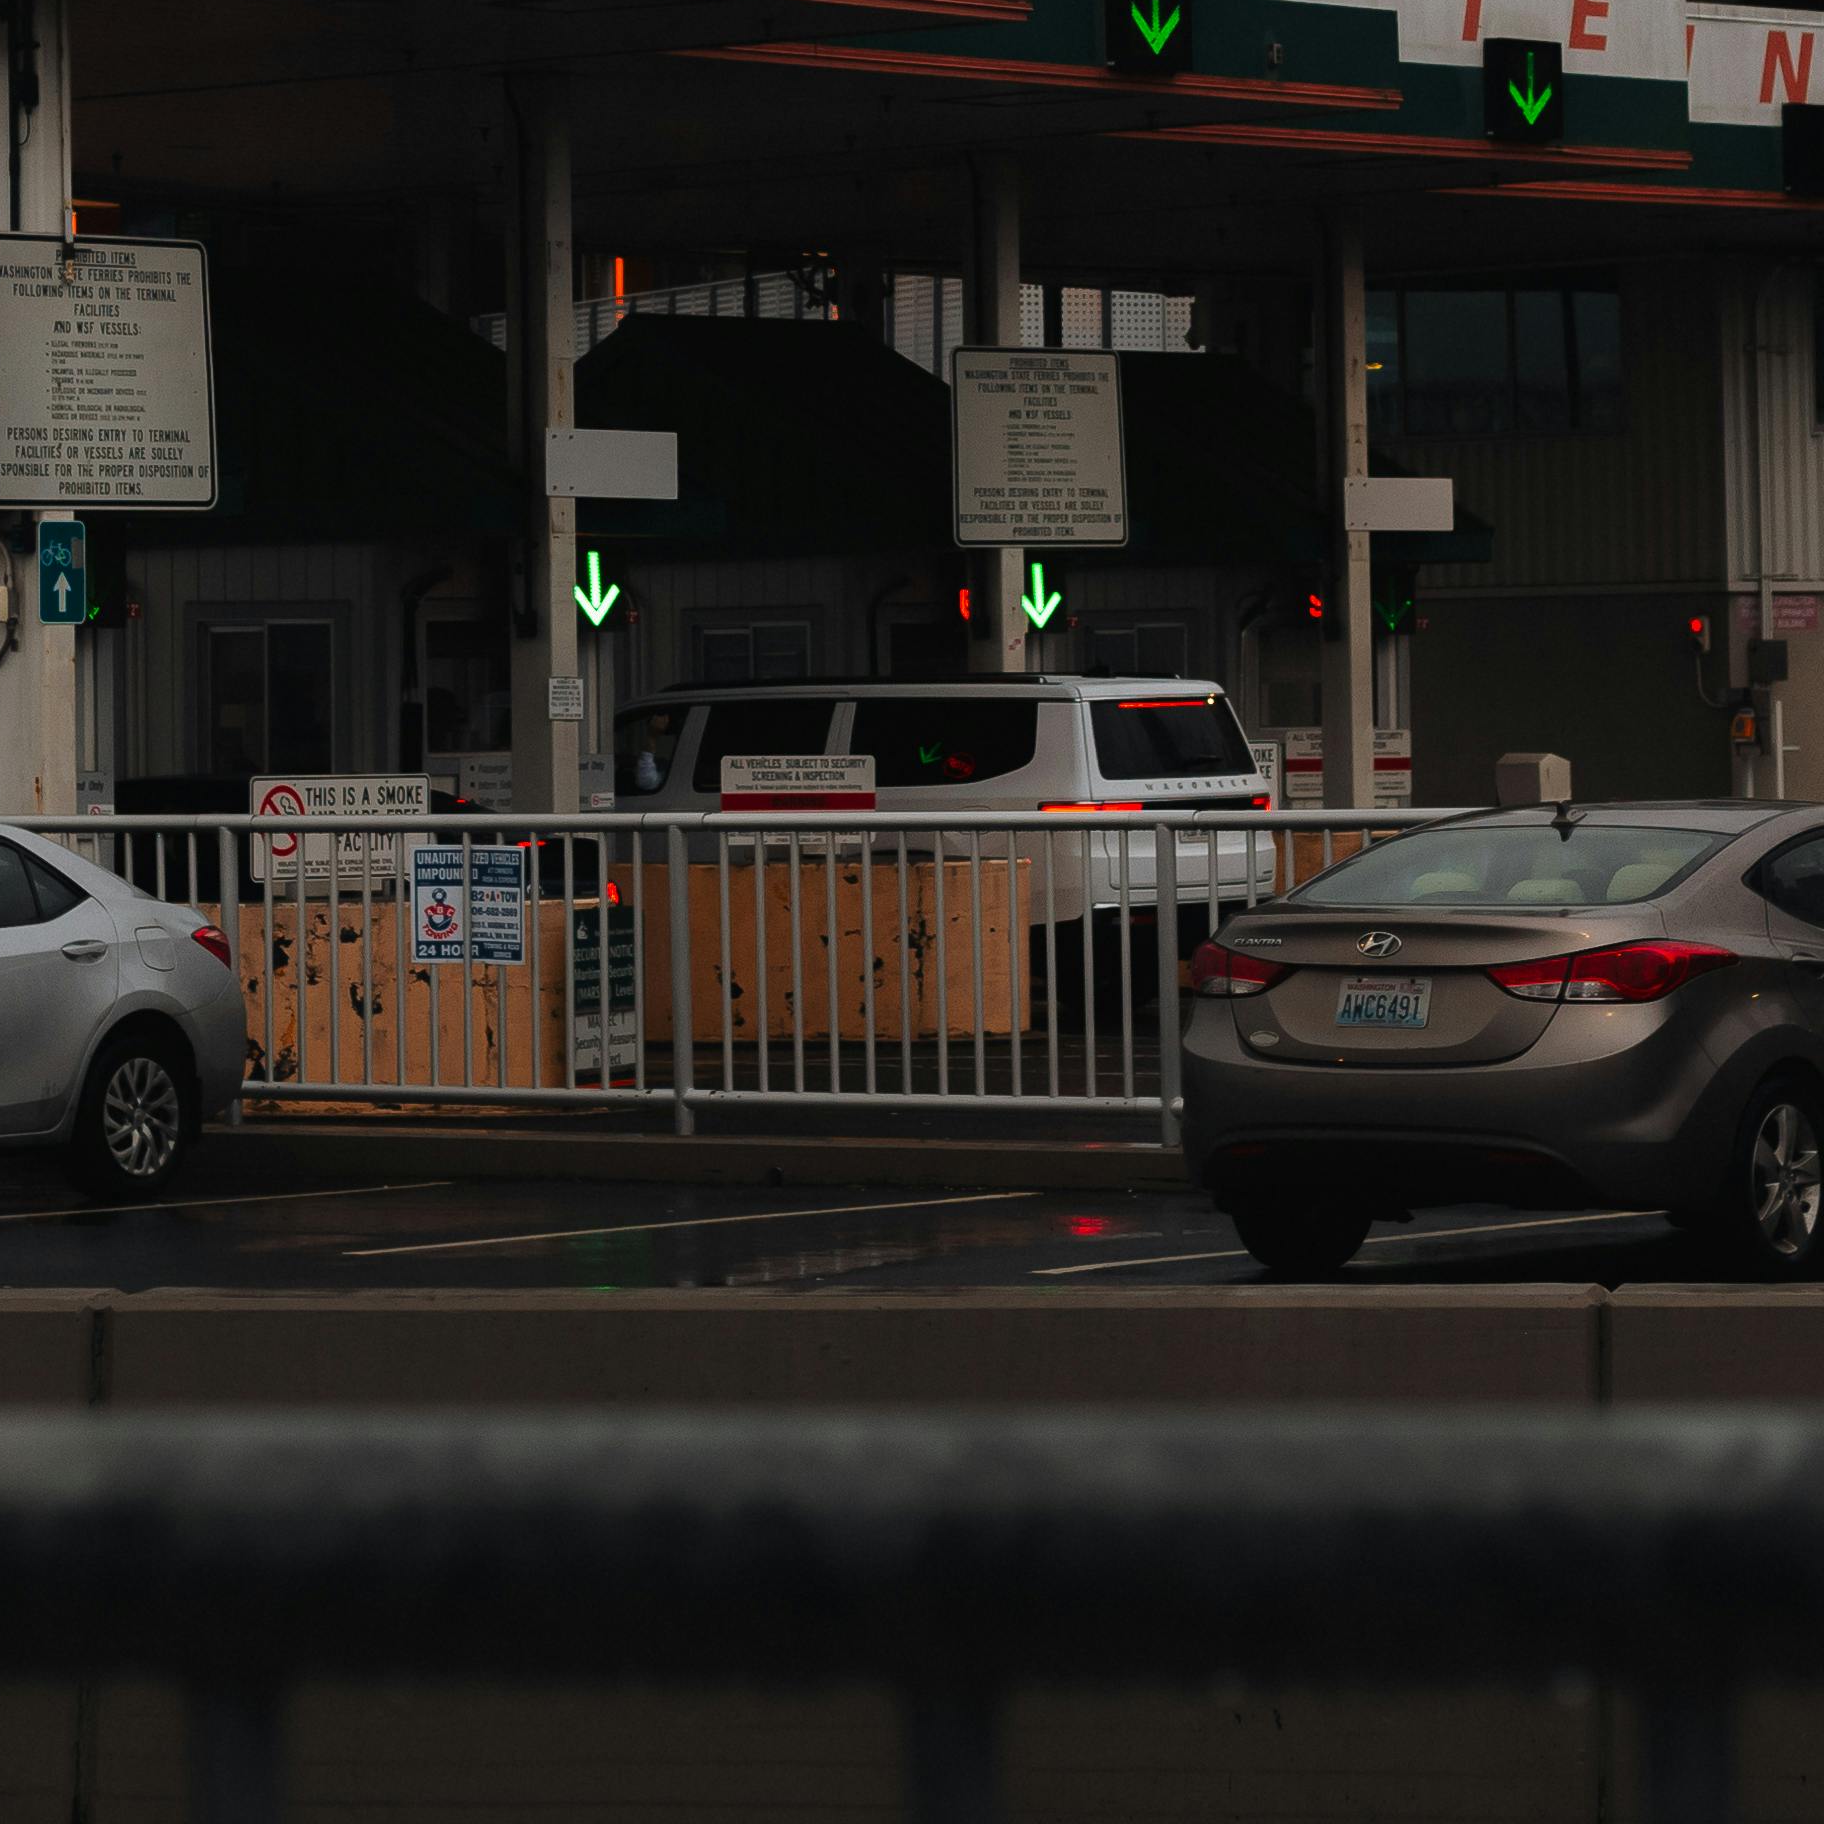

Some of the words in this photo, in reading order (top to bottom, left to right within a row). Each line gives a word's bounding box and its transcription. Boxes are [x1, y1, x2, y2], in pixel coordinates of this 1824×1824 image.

[55, 250, 106, 264] PHIBITED
[111, 252, 136, 265] ITEMS
[88, 268, 123, 282] FERRIES
[128, 270, 172, 285] PROHIBITS
[177, 272, 191, 286] THE
[13, 283, 63, 298] FOLLOWING
[67, 286, 93, 299] ITEMS
[98, 287, 111, 300] ON
[116, 288, 131, 301] THE
[137, 289, 176, 302] TERMINAL
[74, 303, 120, 317] FACILITIES
[53, 320, 71, 334] AND
[76, 322, 94, 335] WSF
[101, 323, 142, 336] VESSELS:
[1011, 370, 1030, 380] STATE
[978, 383, 1016, 393] FOLLOWING
[1041, 384, 1050, 394] ON
[7, 427, 48, 441] PERSONS
[52, 428, 94, 442] DESIRING
[98, 429, 127, 442] ENTRY
[133, 429, 144, 442] TO
[149, 430, 191, 443] TERMINAL
[15, 445, 62, 459] FACILITIES
[67, 446, 79, 459] OR
[85, 446, 123, 460] VESSELS
[129, 447, 146, 460] ARE
[151, 447, 183, 461] SOLELY
[54, 463, 72, 477] FOR
[77, 464, 94, 477] THE
[99, 465, 134, 478] PROPER
[139, 465, 194, 478] DISPOSITION
[198, 465, 210, 479] OF
[59, 482, 111, 495] PROHIBITED
[116, 482, 144, 496] ITEMS.
[974, 488, 1005, 498] PERSONS
[1008, 488, 1039, 498] DESIRING
[1042, 488, 1062, 498] ENTRY
[1067, 488, 1075, 498] TO
[980, 500, 1015, 510] FACILITIES
[1019, 501, 1028, 511] OR
[1031, 501, 1060, 511] VESSELS
[1064, 501, 1077, 511] ARE
[1080, 501, 1104, 511] SOLELY
[1010, 514, 1023, 524] FOR
[1027, 514, 1039, 524] THE
[1042, 514, 1068, 524] PROPER
[1253, 748, 1275, 762] OKE
[730, 759, 744, 769] ALL
[746, 759, 781, 769] VEHICLES
[785, 759, 818, 769] SUBJECT
[820, 759, 829, 768] TO
[830, 759, 866, 768] SECURITY
[751, 771, 792, 781] SCREENING
[794, 771, 801, 781] &
[803, 771, 845, 781] INSPECTION
[1145, 779, 1248, 791] WAGONEER
[305, 787, 336, 806] THIS
[342, 786, 356, 806] IS
[361, 786, 371, 805] A
[377, 785, 423, 806] SMOKE
[490, 852, 520, 865] VEHICLES
[417, 867, 478, 880] IMPOUND
[422, 923, 459, 940] TOWING
[1233, 937, 1282, 945] ELANTRA
[418, 944, 436, 956] 24
[441, 944, 479, 957] HOR
[573, 947, 601, 962] SECURIT
[609, 944, 633, 958] NOTIC
[1347, 983, 1396, 991] WASHINGTON
[1341, 994, 1420, 1022] AWC6491
